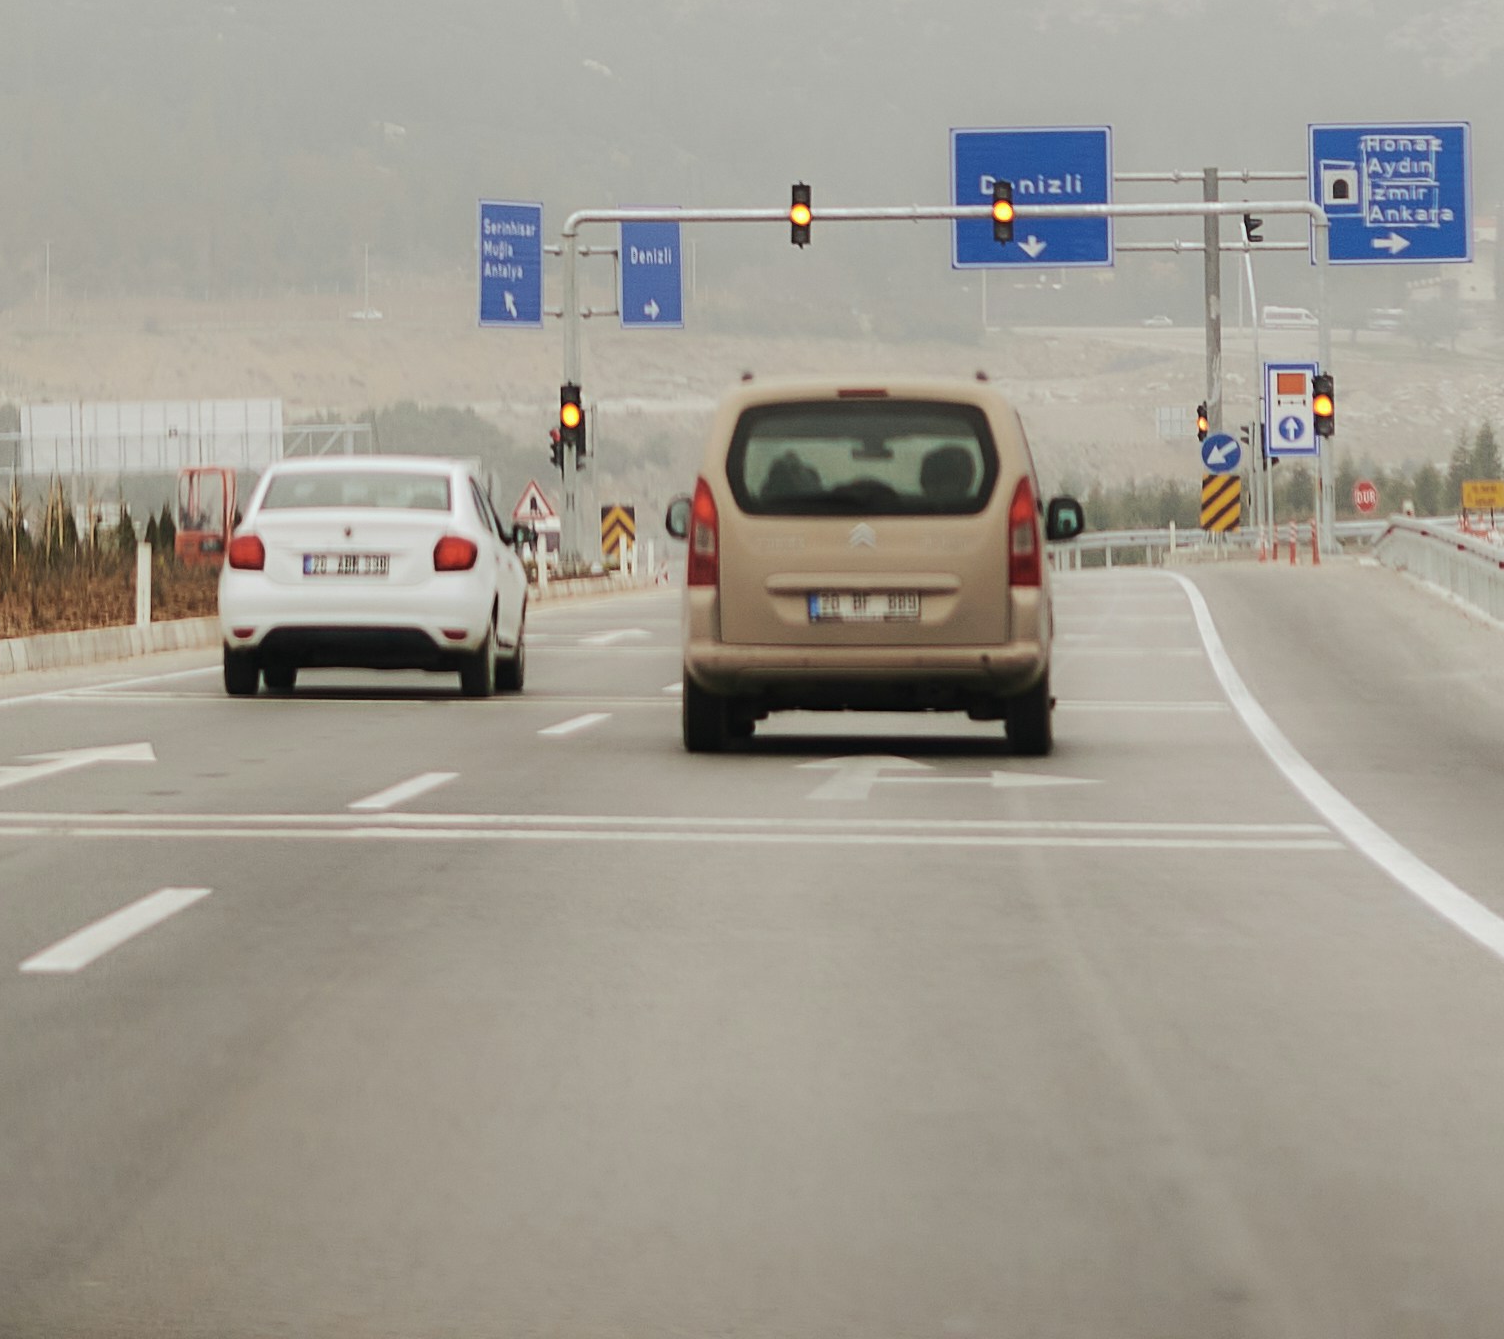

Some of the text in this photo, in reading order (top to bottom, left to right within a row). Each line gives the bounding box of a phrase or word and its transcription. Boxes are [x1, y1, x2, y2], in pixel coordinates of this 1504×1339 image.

[1368, 157, 1432, 177] Aydın
[980, 173, 1082, 195] Dnizli
[1369, 204, 1454, 222] Ankara
[630, 245, 672, 265] Denizli
[484, 261, 524, 282] Antalya
[1357, 490, 1376, 504] DUR
